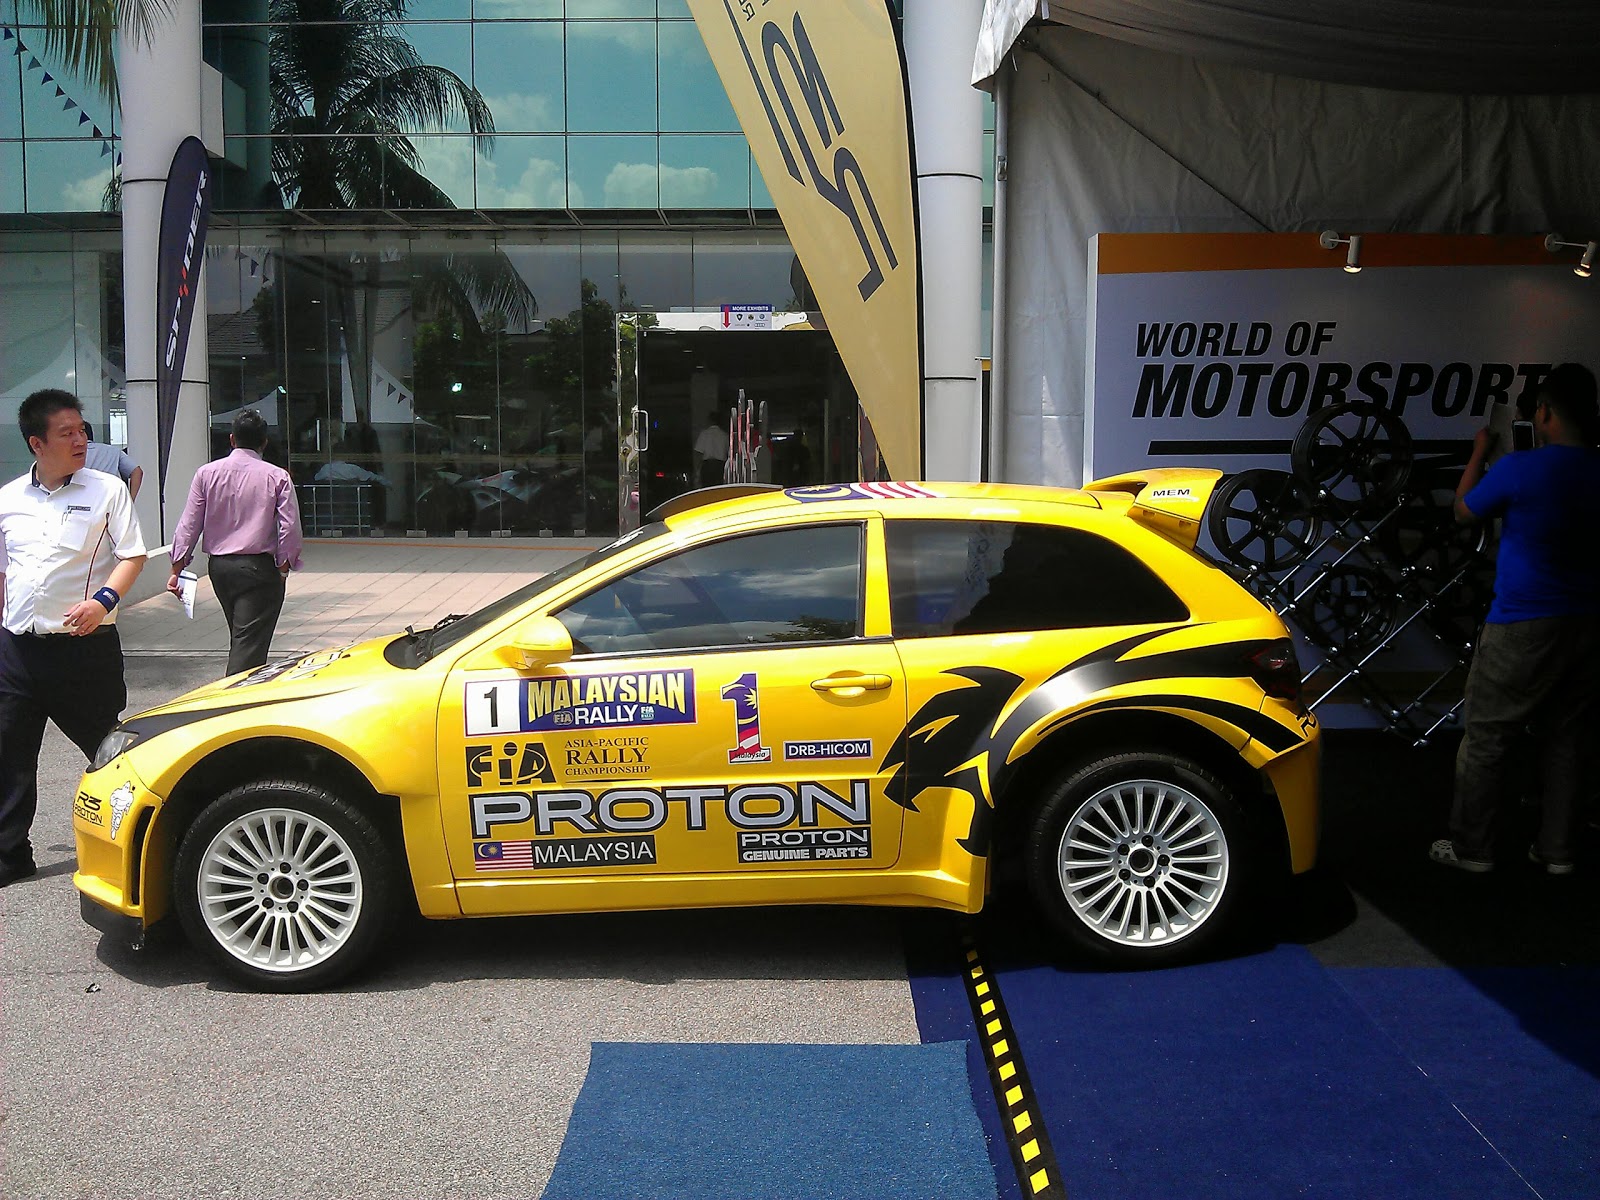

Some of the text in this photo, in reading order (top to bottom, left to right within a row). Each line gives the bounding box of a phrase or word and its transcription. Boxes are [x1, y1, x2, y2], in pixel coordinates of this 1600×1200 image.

[1136, 320, 1337, 357] WORLD OF
[1152, 488, 1191, 497] MEM
[483, 672, 686, 728] 1 MALAYSIAN
[574, 704, 639, 725] RALLY
[564, 737, 649, 749] ASIA-PACIFIC
[788, 742, 868, 756] DRB-HICOM
[565, 747, 648, 765] RALLY
[564, 765, 651, 777] CHAMPIONSHIP
[468, 779, 872, 838] PROTON
[741, 829, 868, 847] PROTON
[534, 840, 653, 863] MALAYSIA
[742, 846, 869, 861] GENUINE PARTS
